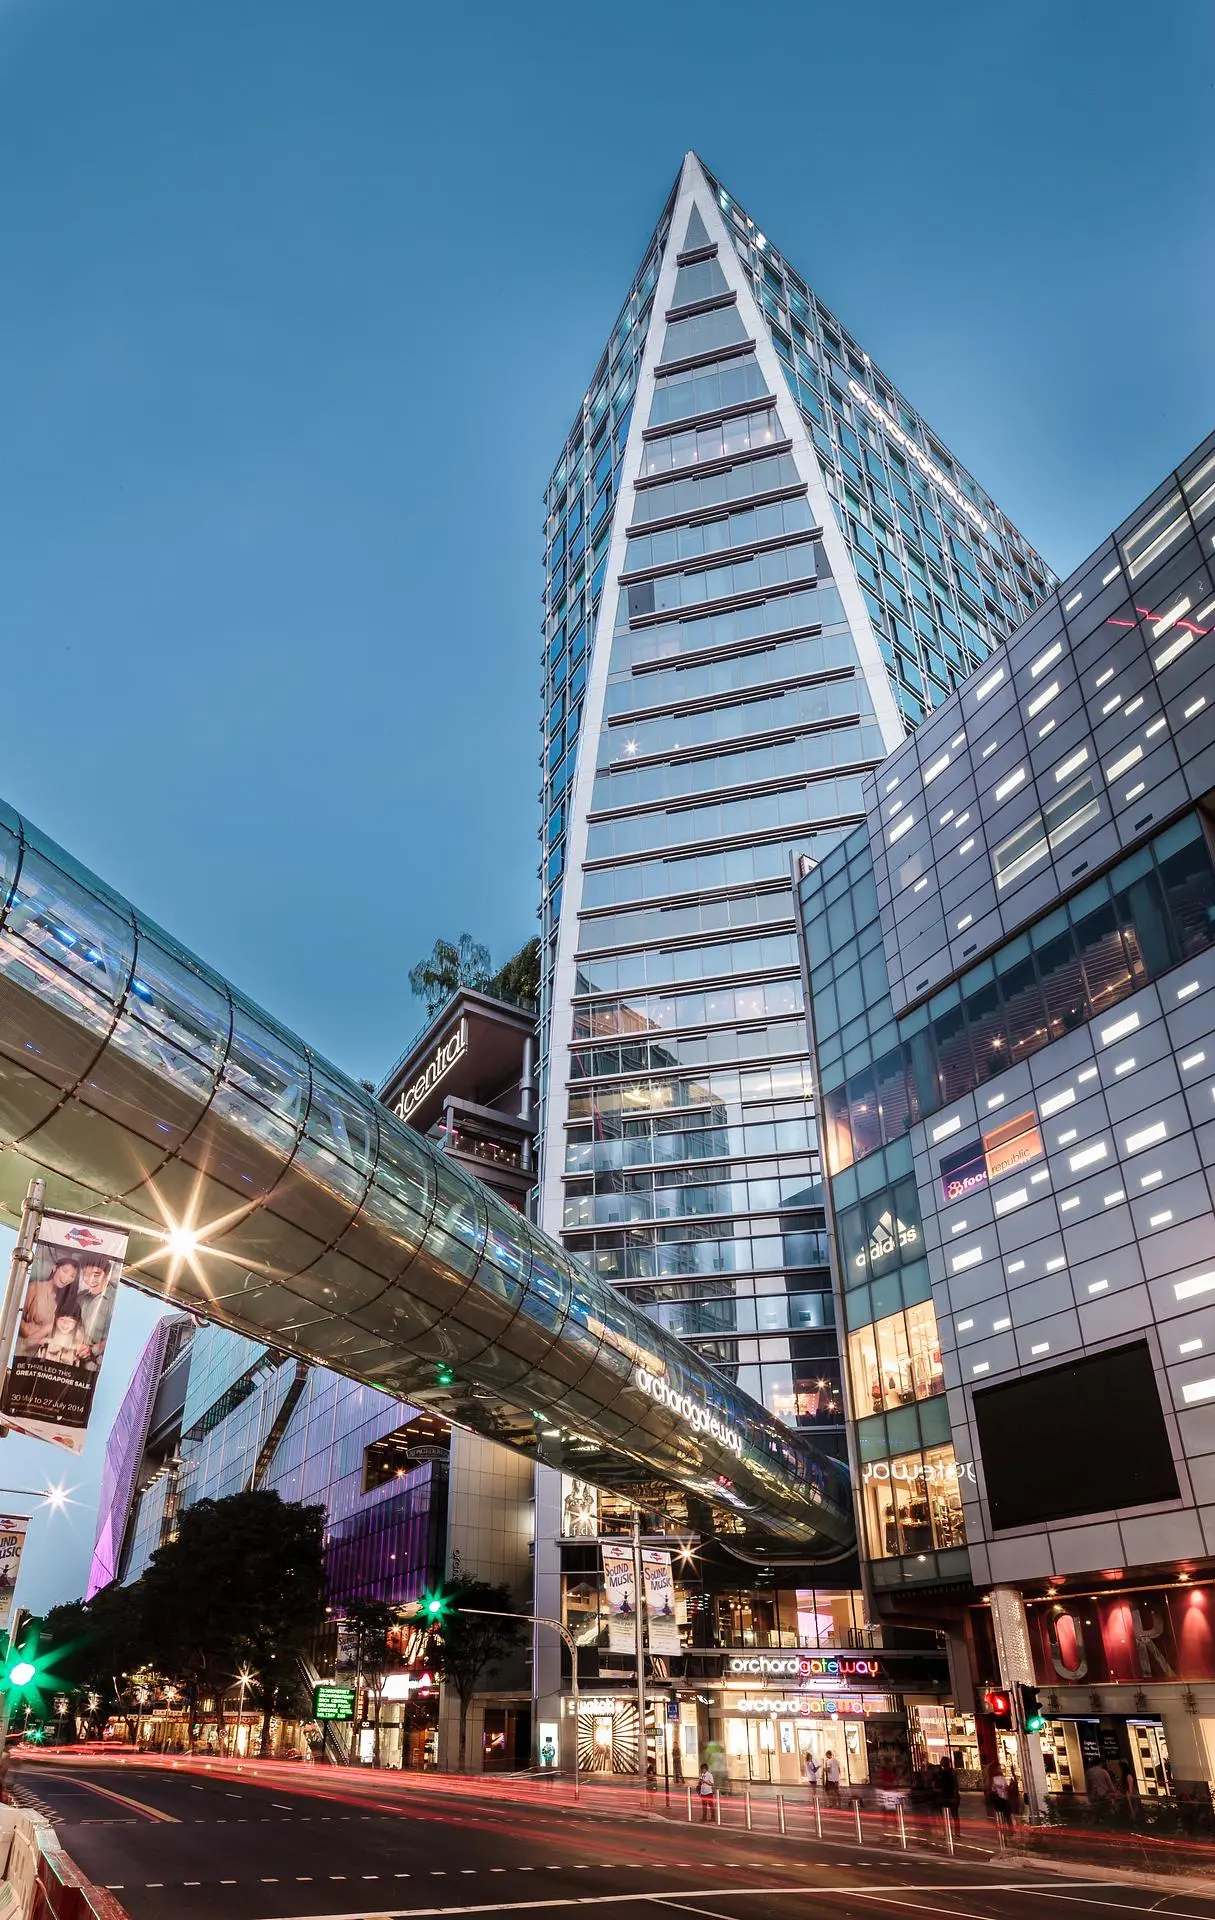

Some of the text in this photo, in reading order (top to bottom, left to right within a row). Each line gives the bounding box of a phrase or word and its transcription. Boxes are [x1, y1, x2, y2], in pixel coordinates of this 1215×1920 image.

[991, 1148, 1031, 1175] republic
[855, 1228, 917, 1268] adidas
[27, 1363, 57, 1374] THRILLED
[58, 1369, 72, 1378] THIS
[36, 1371, 74, 1386] SINGAPORE
[11, 1394, 21, 1402] 30
[53, 1401, 66, 1411] July
[67, 1403, 84, 1414] 2014
[635, 1367, 742, 1459] orchardgateway
[609, 1573, 633, 1588] MUSIC
[650, 1577, 672, 1591] MUSIC
[731, 1655, 879, 1678] orchardgateway
[737, 1697, 872, 1718] orchardgateway
